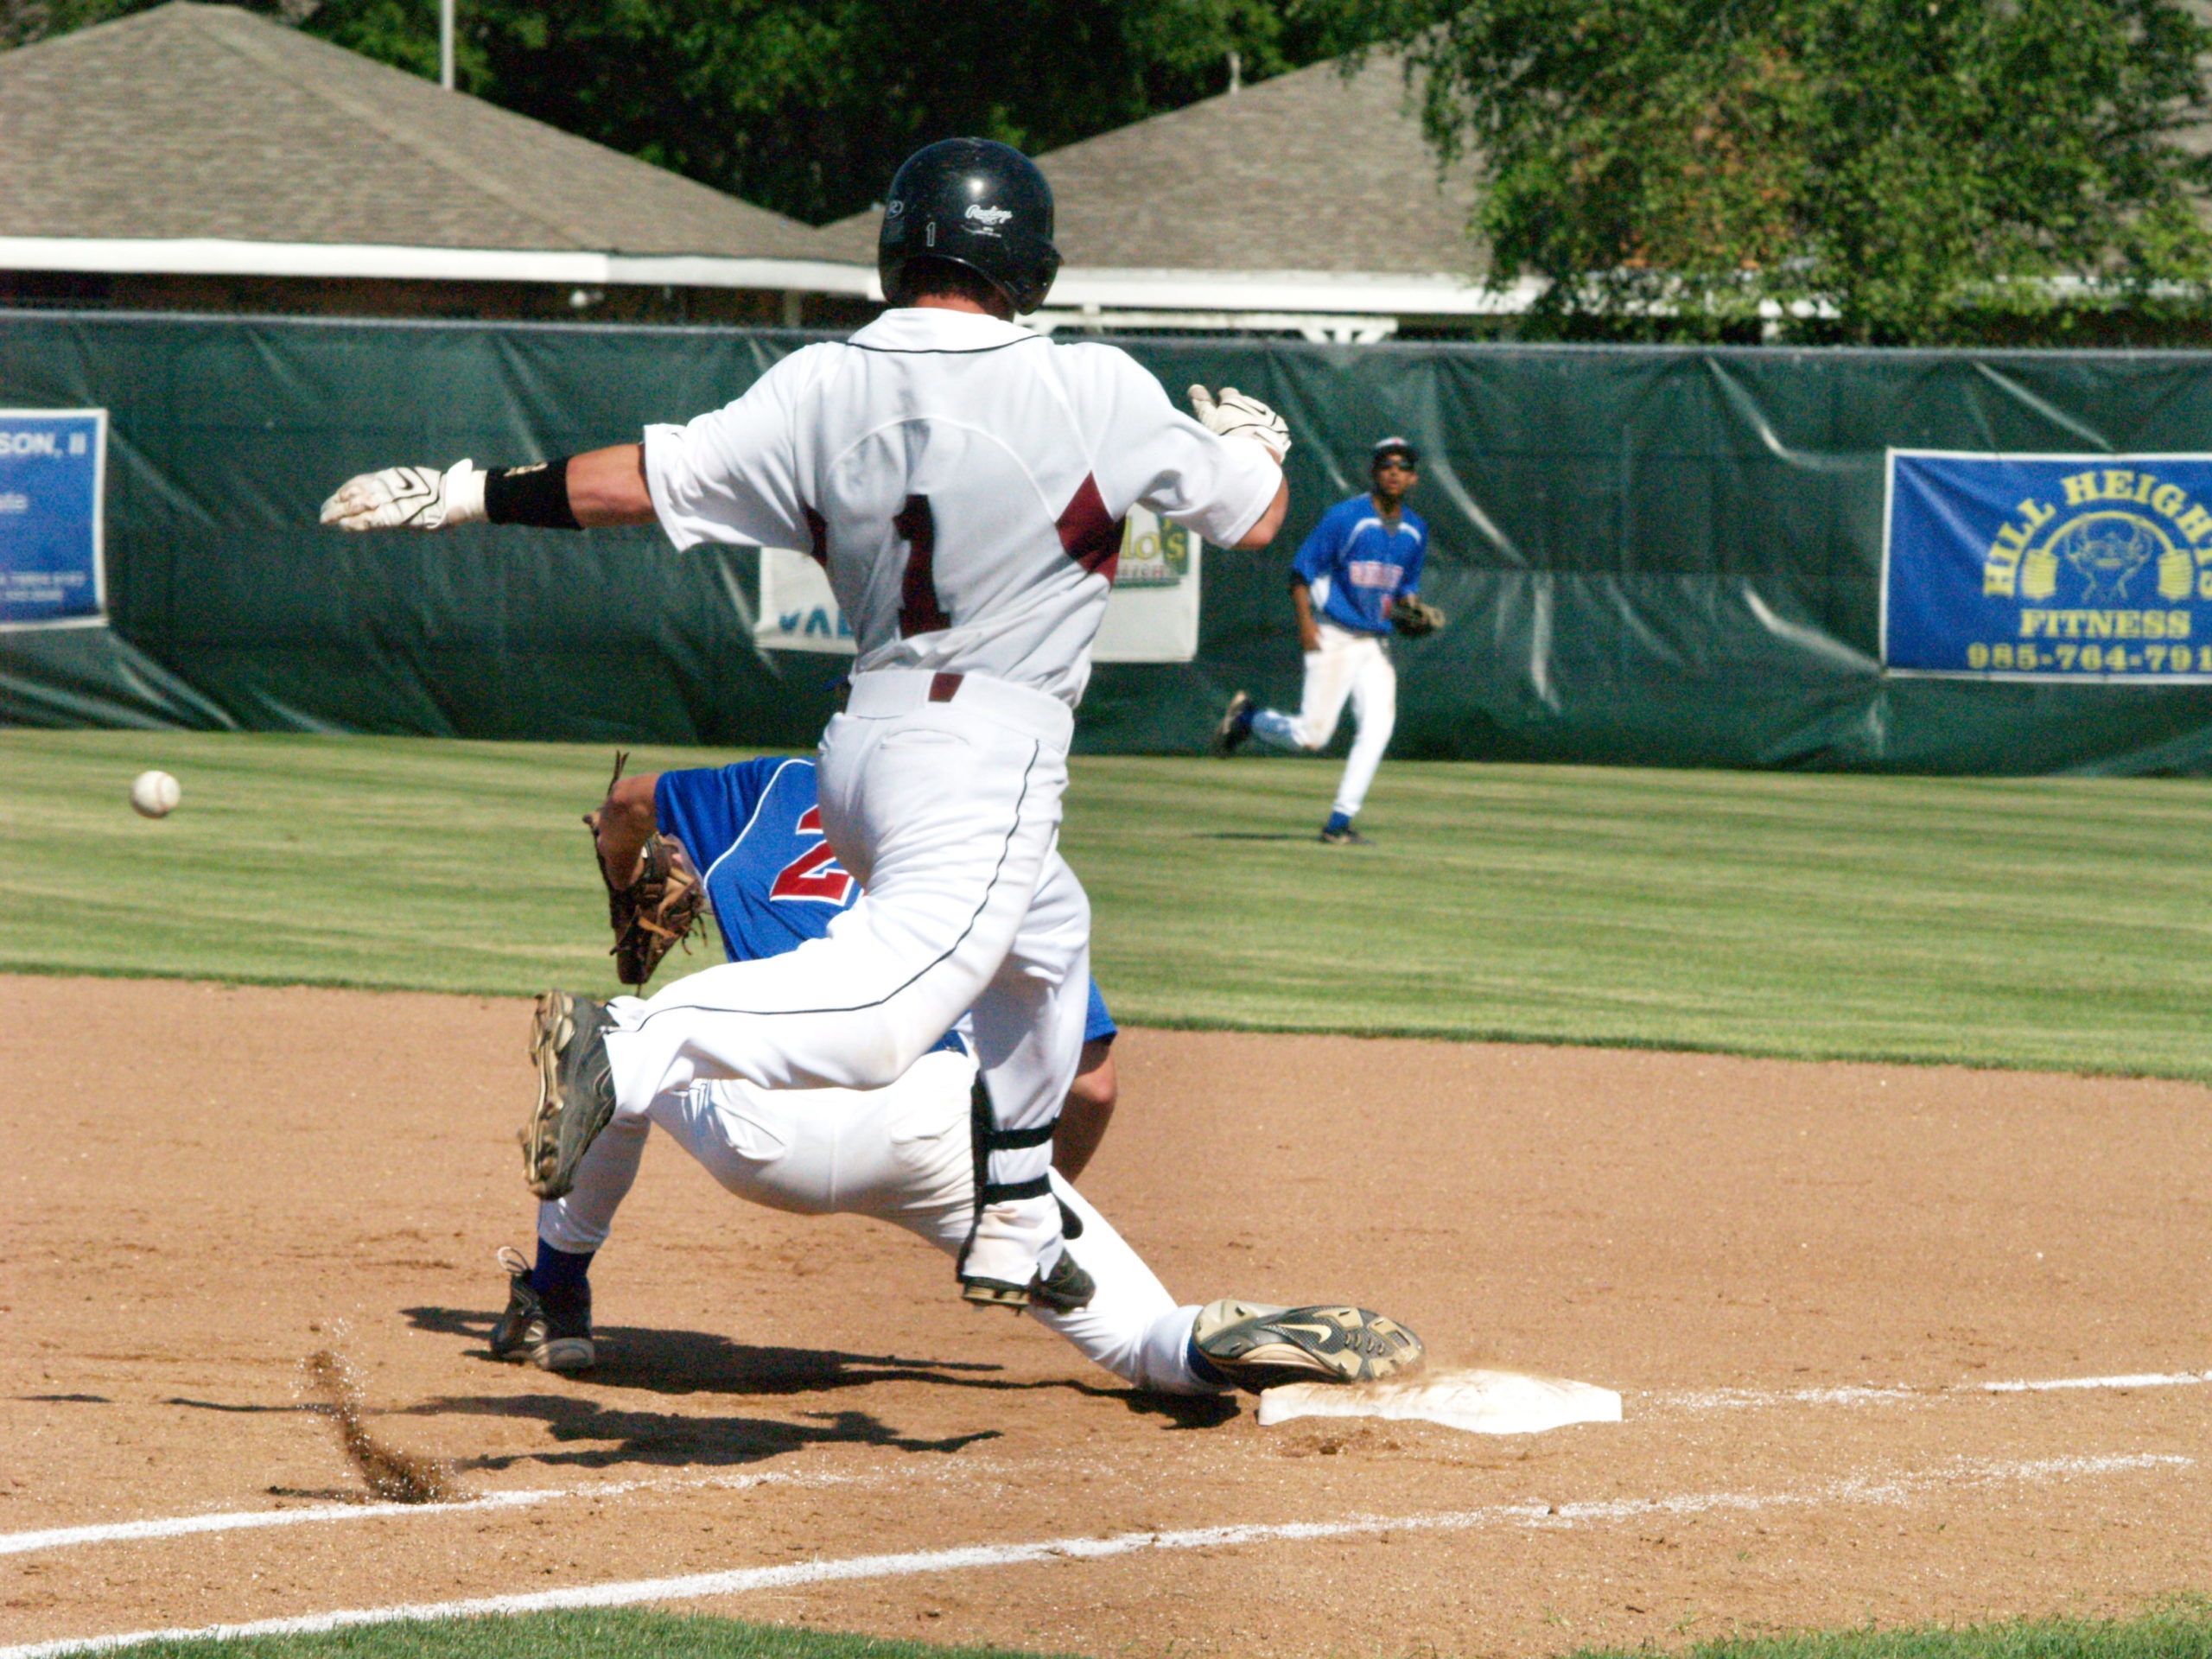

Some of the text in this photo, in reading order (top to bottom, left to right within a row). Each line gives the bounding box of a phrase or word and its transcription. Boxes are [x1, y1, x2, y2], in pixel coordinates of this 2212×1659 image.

[926, 221, 936, 247] 1
[892, 493, 953, 640] 1
[1984, 499, 2056, 596] HILL
[2019, 608, 2191, 639] FITNESS
